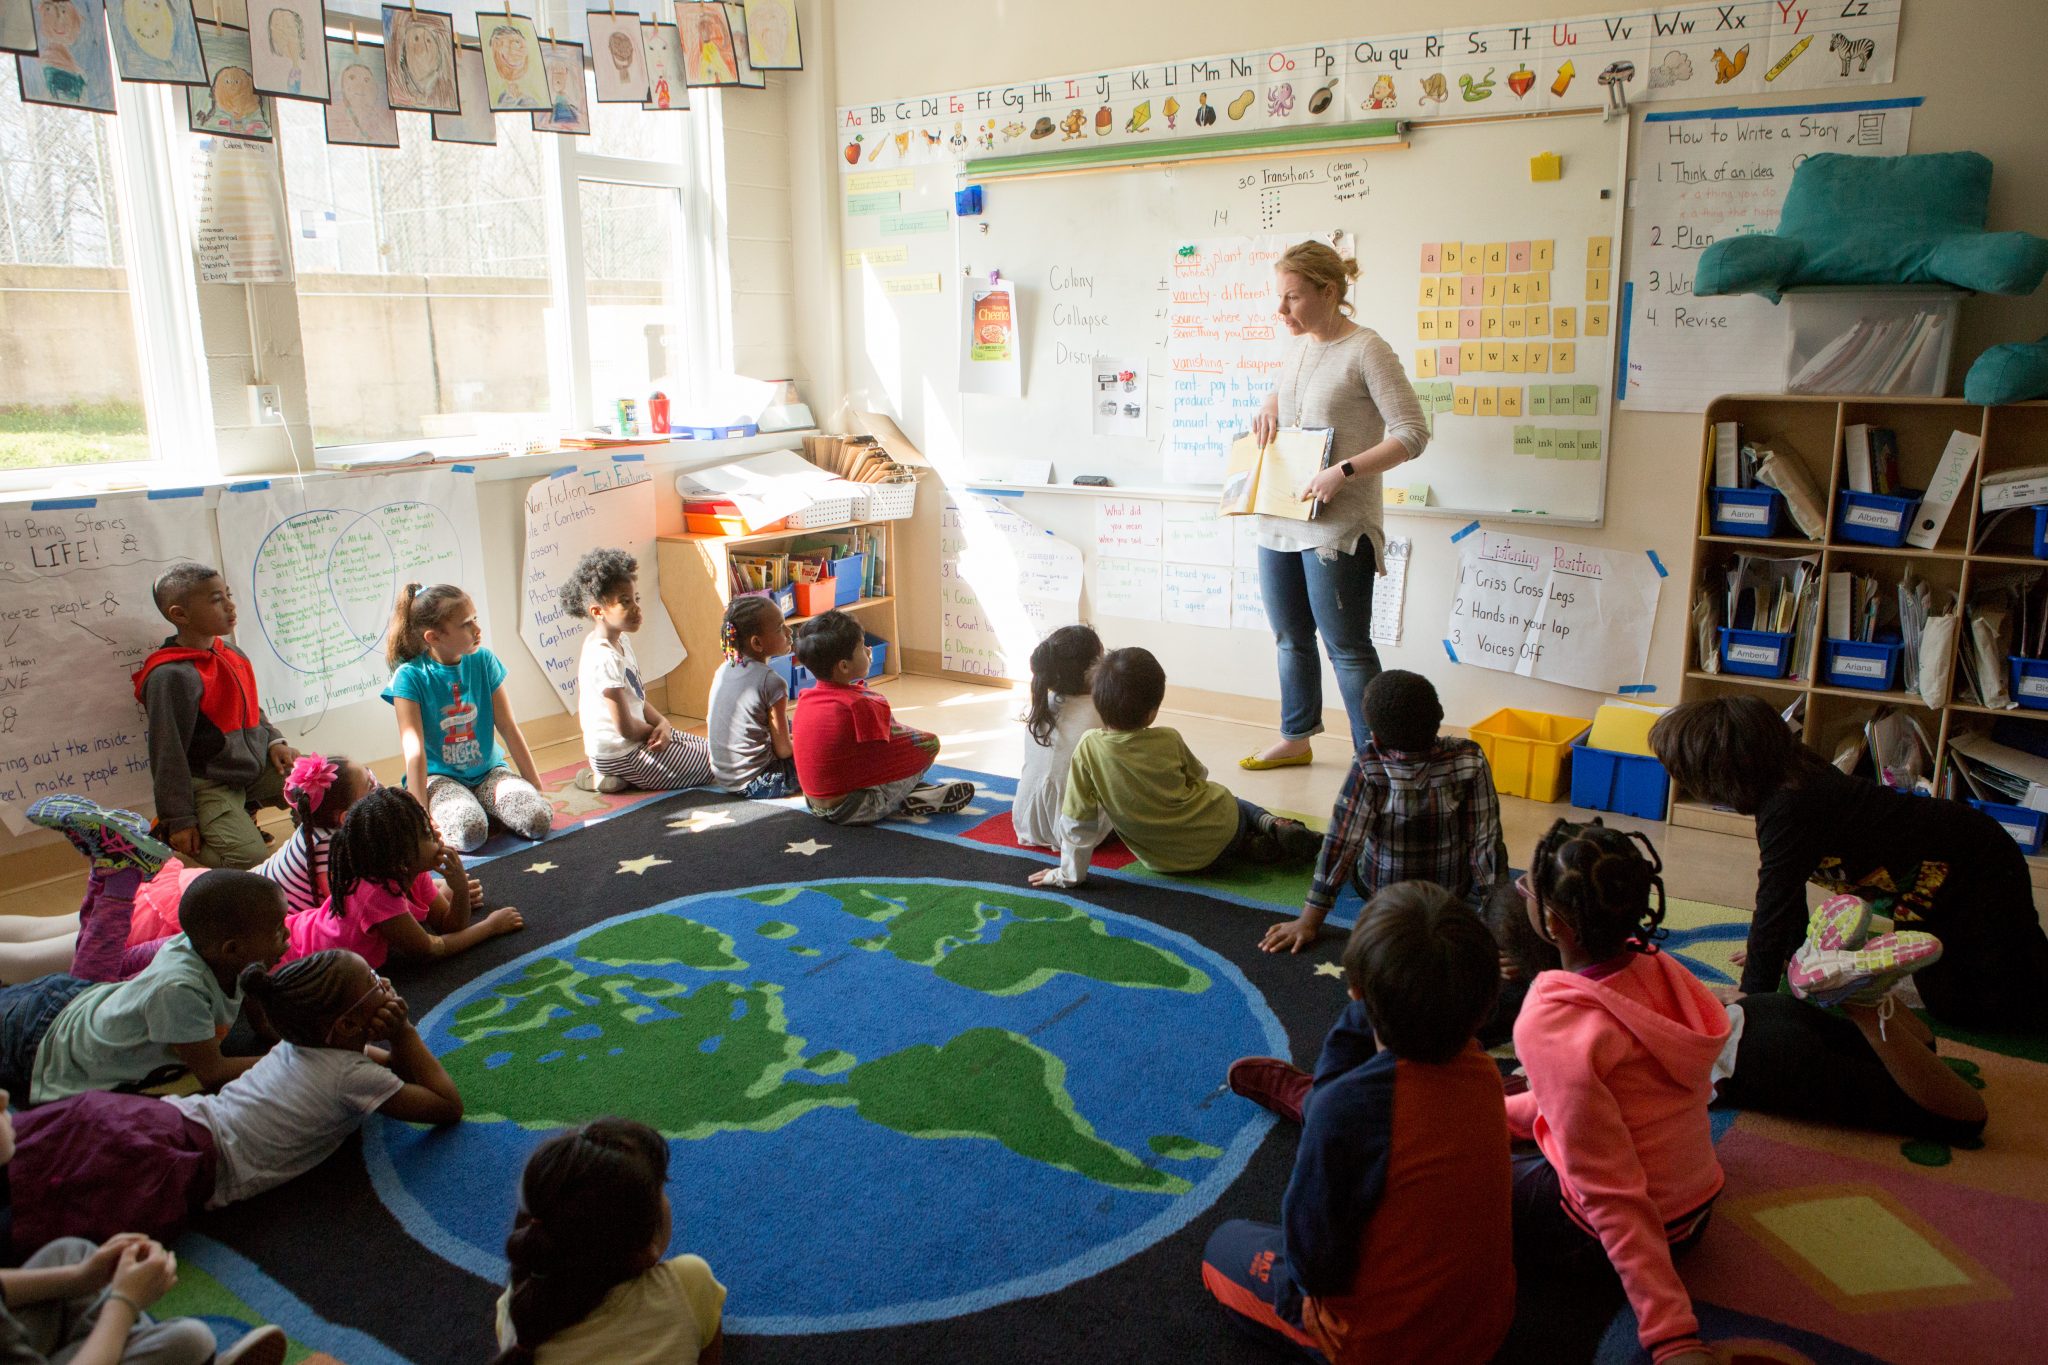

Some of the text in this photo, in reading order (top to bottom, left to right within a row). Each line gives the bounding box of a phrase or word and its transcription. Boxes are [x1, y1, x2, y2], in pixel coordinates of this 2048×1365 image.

[846, 110, 862, 128] Aa
[871, 106, 886, 124] Bb
[896, 102, 911, 120] Cc
[922, 98, 938, 117] Dd
[950, 96, 964, 114] Ee
[977, 91, 992, 110] Ff
[1002, 88, 1024, 114] Gg
[1033, 84, 1052, 103] Hh
[1064, 80, 1080, 99] Ii
[1096, 76, 1110, 102] Jj
[1132, 71, 1150, 90] Kk
[1165, 66, 1177, 86] Ll
[1191, 62, 1220, 83] Mm
[1230, 58, 1252, 78] Nn
[1268, 52, 1296, 73] Oo
[1314, 47, 1334, 76] Pp
[1354, 42, 1382, 63] Qu
[1389, 48, 1408, 70] qu
[1426, 36, 1444, 58] Rr
[1468, 32, 1488, 54] Ss
[1509, 27, 1532, 50] Tt
[1553, 24, 1576, 46] Uu
[1605, 18, 1632, 41] Vv
[1654, 12, 1695, 36] Ww
[1716, 6, 1746, 31] Xx
[1778, 0, 1808, 34] Yy
[1668, 117, 1839, 145] How to Write a Story
[1238, 166, 1314, 190] 30 Transitions
[1671, 161, 1774, 181] Think of an idea
[1214, 210, 1228, 227] 14
[1651, 226, 1714, 246] 2 Plan
[1213, 246, 1280, 270] plant grown
[1448, 252, 1499, 261] b d
[203, 272, 227, 281] Ebony
[1050, 265, 1093, 298] Colony
[1650, 270, 1660, 292] 3
[1173, 280, 1271, 306] variety different
[1426, 283, 1520, 298] g h k
[1053, 303, 1110, 334] Collapse
[1212, 308, 1240, 323] where
[1248, 314, 1265, 326] you
[1488, 318, 1496, 328] p
[1509, 320, 1520, 328] qu
[1675, 308, 1728, 328] Revise
[1172, 326, 1269, 342] something you need
[1533, 353, 1541, 364] y
[1210, 376, 1239, 398] pay to
[1174, 392, 1261, 413] produce make
[1505, 398, 1515, 406] ck
[1172, 412, 1208, 428] annual
[1515, 436, 1532, 444] ank
[584, 470, 612, 491] Text
[613, 464, 652, 486] Features
[542, 501, 596, 532] of Contents
[1104, 504, 1142, 516] What did
[1730, 510, 1755, 518] Aaron
[1857, 512, 1888, 524] Alberto
[5, 512, 126, 542] to Bring Stories
[1110, 524, 1122, 536] you
[1098, 536, 1114, 544] when
[1118, 537, 1127, 546] you
[31, 537, 100, 568] LIFE!
[1481, 532, 1601, 575] Listening Position
[1166, 566, 1198, 578] I heard
[954, 589, 978, 604] Count
[1206, 586, 1222, 594] and
[1476, 569, 1575, 608] Criss Cross Legs
[0, 596, 90, 622] reeze people
[1185, 603, 1205, 613] agree
[956, 617, 979, 630] Count
[1472, 601, 1505, 623] Hands
[1509, 615, 1519, 625] in
[1523, 619, 1546, 632] your
[1552, 619, 1570, 640] lap
[540, 623, 584, 648] Captions
[1477, 633, 1515, 657] Voices
[1520, 643, 1545, 662] Off
[1736, 650, 1769, 661] Amberly
[546, 656, 574, 672] Maps
[961, 659, 1006, 677] 100 chart
[1844, 662, 1872, 672] Ariana
[266, 673, 381, 716] How are hummingbirds
[34, 740, 89, 765] out the
[35, 761, 119, 795] make people
